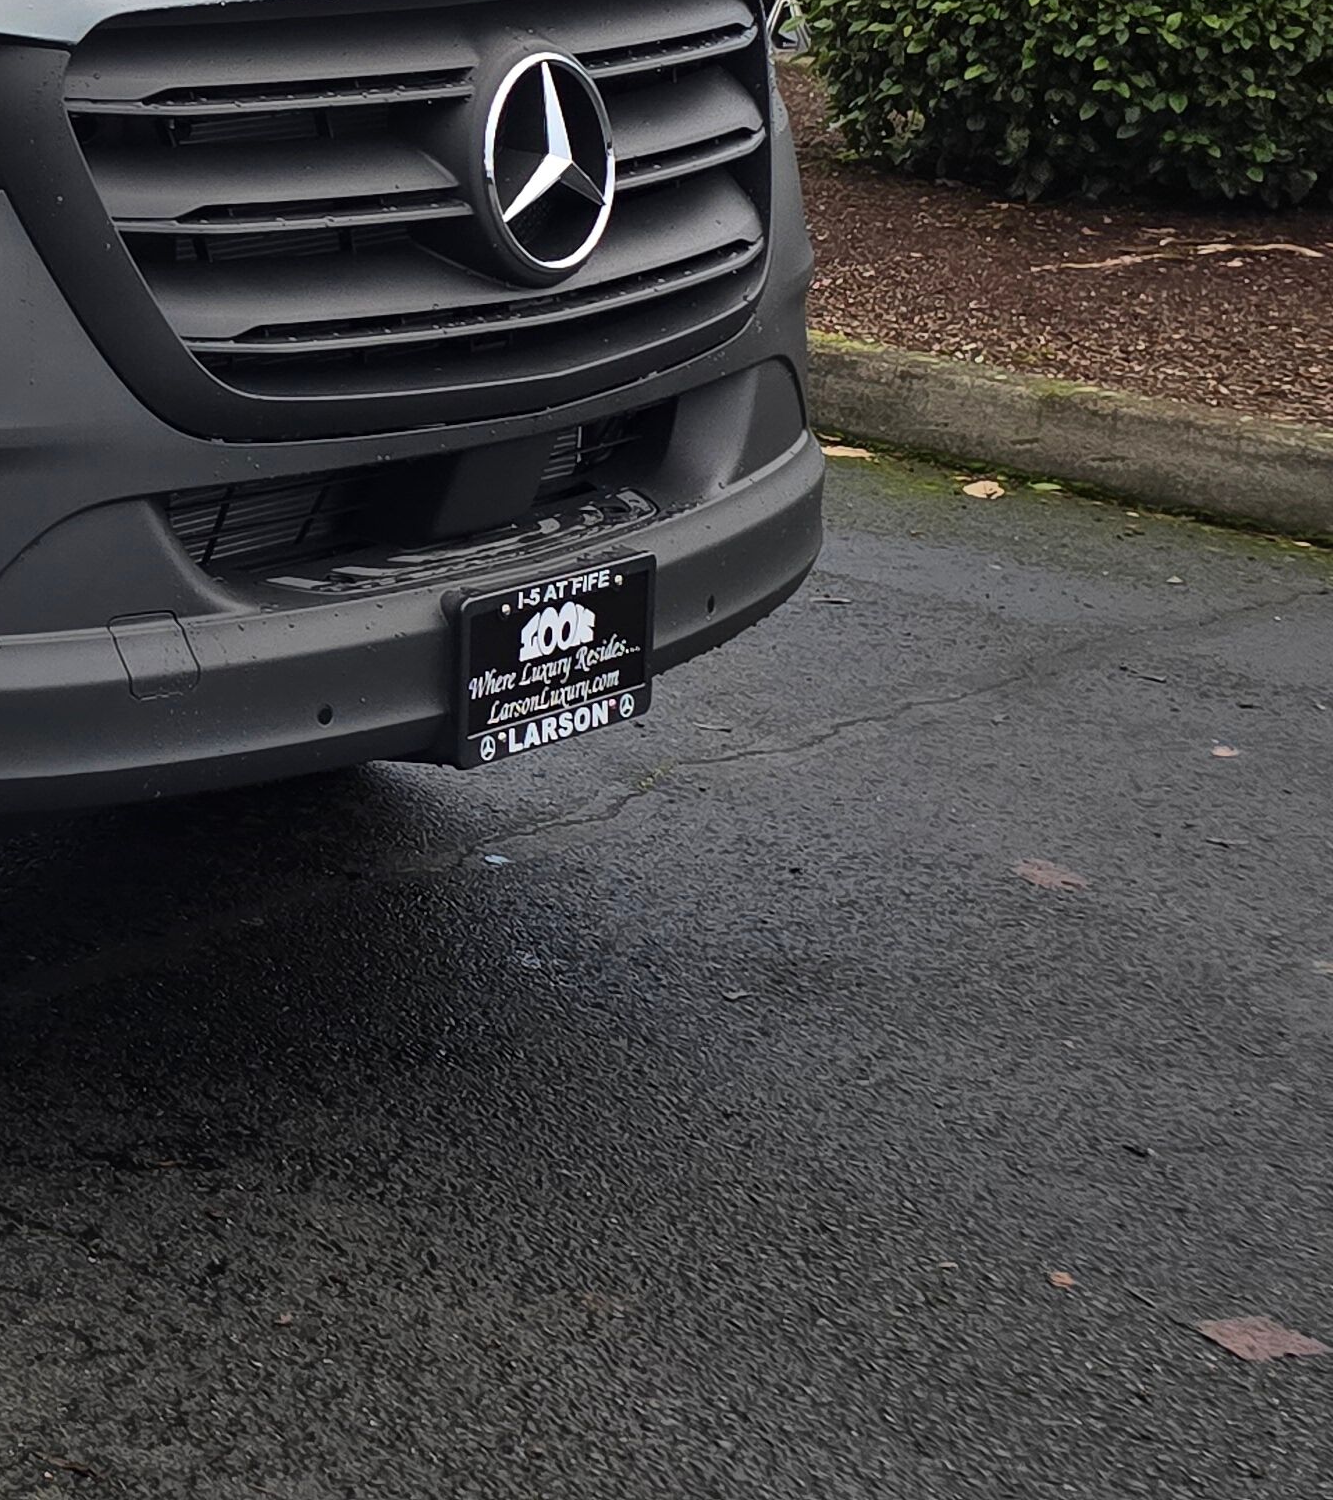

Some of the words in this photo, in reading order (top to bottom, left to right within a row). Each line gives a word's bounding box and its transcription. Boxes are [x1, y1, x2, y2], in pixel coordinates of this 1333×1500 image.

[517, 588, 541, 610] I-5
[543, 580, 568, 603] AT
[571, 569, 611, 596] FIFE
[468, 668, 517, 700] Where
[519, 655, 572, 687] Luxury
[486, 669, 620, 725] LarsonLuxury.com
[508, 700, 609, 753] LARSON
